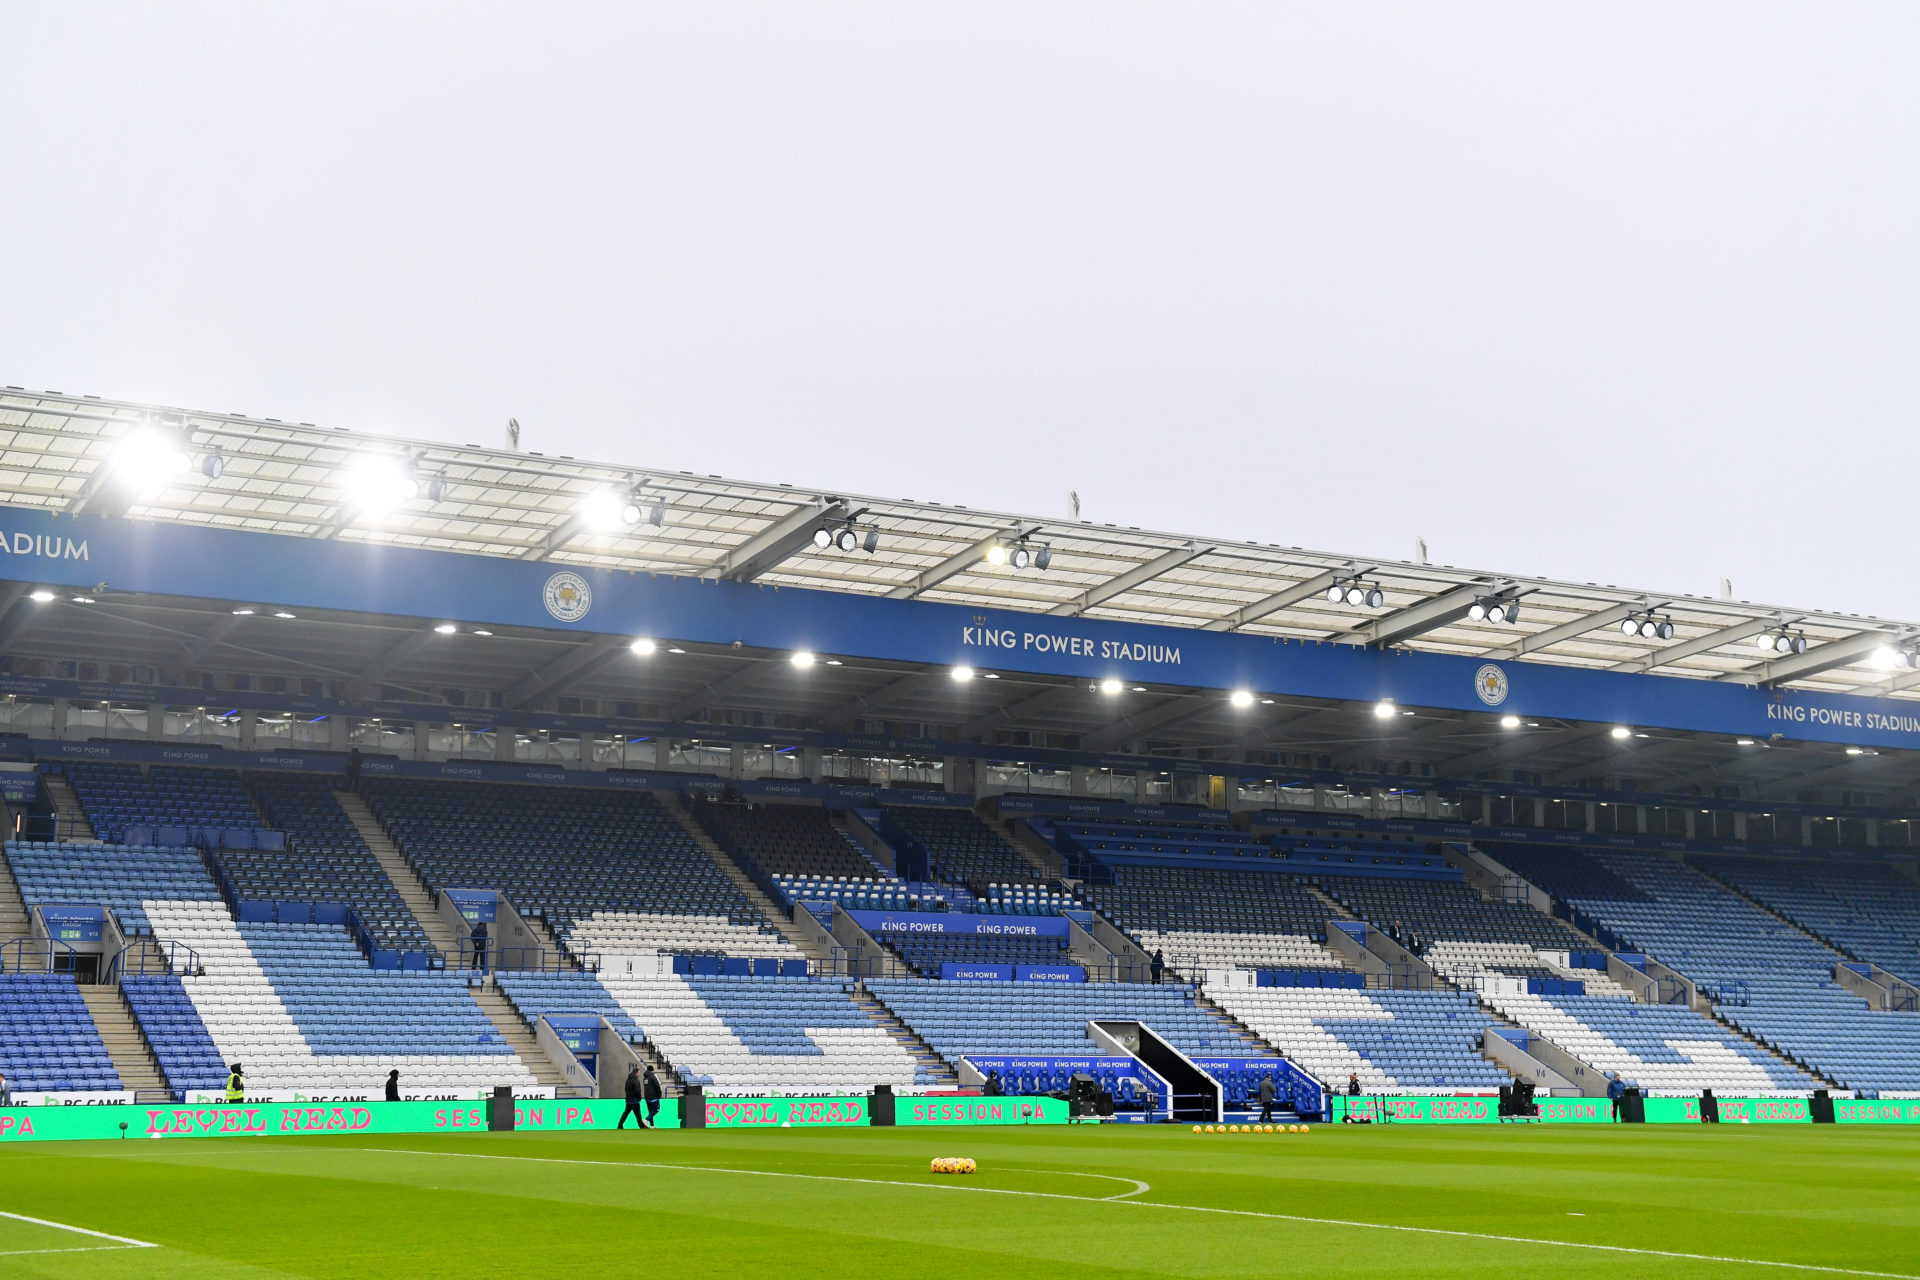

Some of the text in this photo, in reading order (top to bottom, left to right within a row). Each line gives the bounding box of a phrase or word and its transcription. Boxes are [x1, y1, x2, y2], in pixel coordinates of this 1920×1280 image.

[963, 626, 1181, 665] KING POWER STADIUM
[1767, 703, 1806, 722] KING
[1810, 707, 1863, 728] POWER
[881, 921, 944, 933] KING POWER
[976, 925, 1037, 936] KING POWER
[1138, 1067, 1160, 1088] KING POWER
[1289, 1070, 1312, 1089] KING POWER
[1536, 1068, 1545, 1078] V4
[1574, 1066, 1584, 1076] V4
[435, 1107, 595, 1127] SESON IPA
[705, 1102, 862, 1124] EVEL HEAD
[914, 1103, 1045, 1121] SESSION IPA
[1430, 1101, 1487, 1120] HEAD
[1537, 1104, 1596, 1119] ESSION
[1684, 1102, 1806, 1120] LEL HEAD
[1839, 1105, 1901, 1120] SESSION
[145, 1107, 371, 1133] LEVEL HEAD
